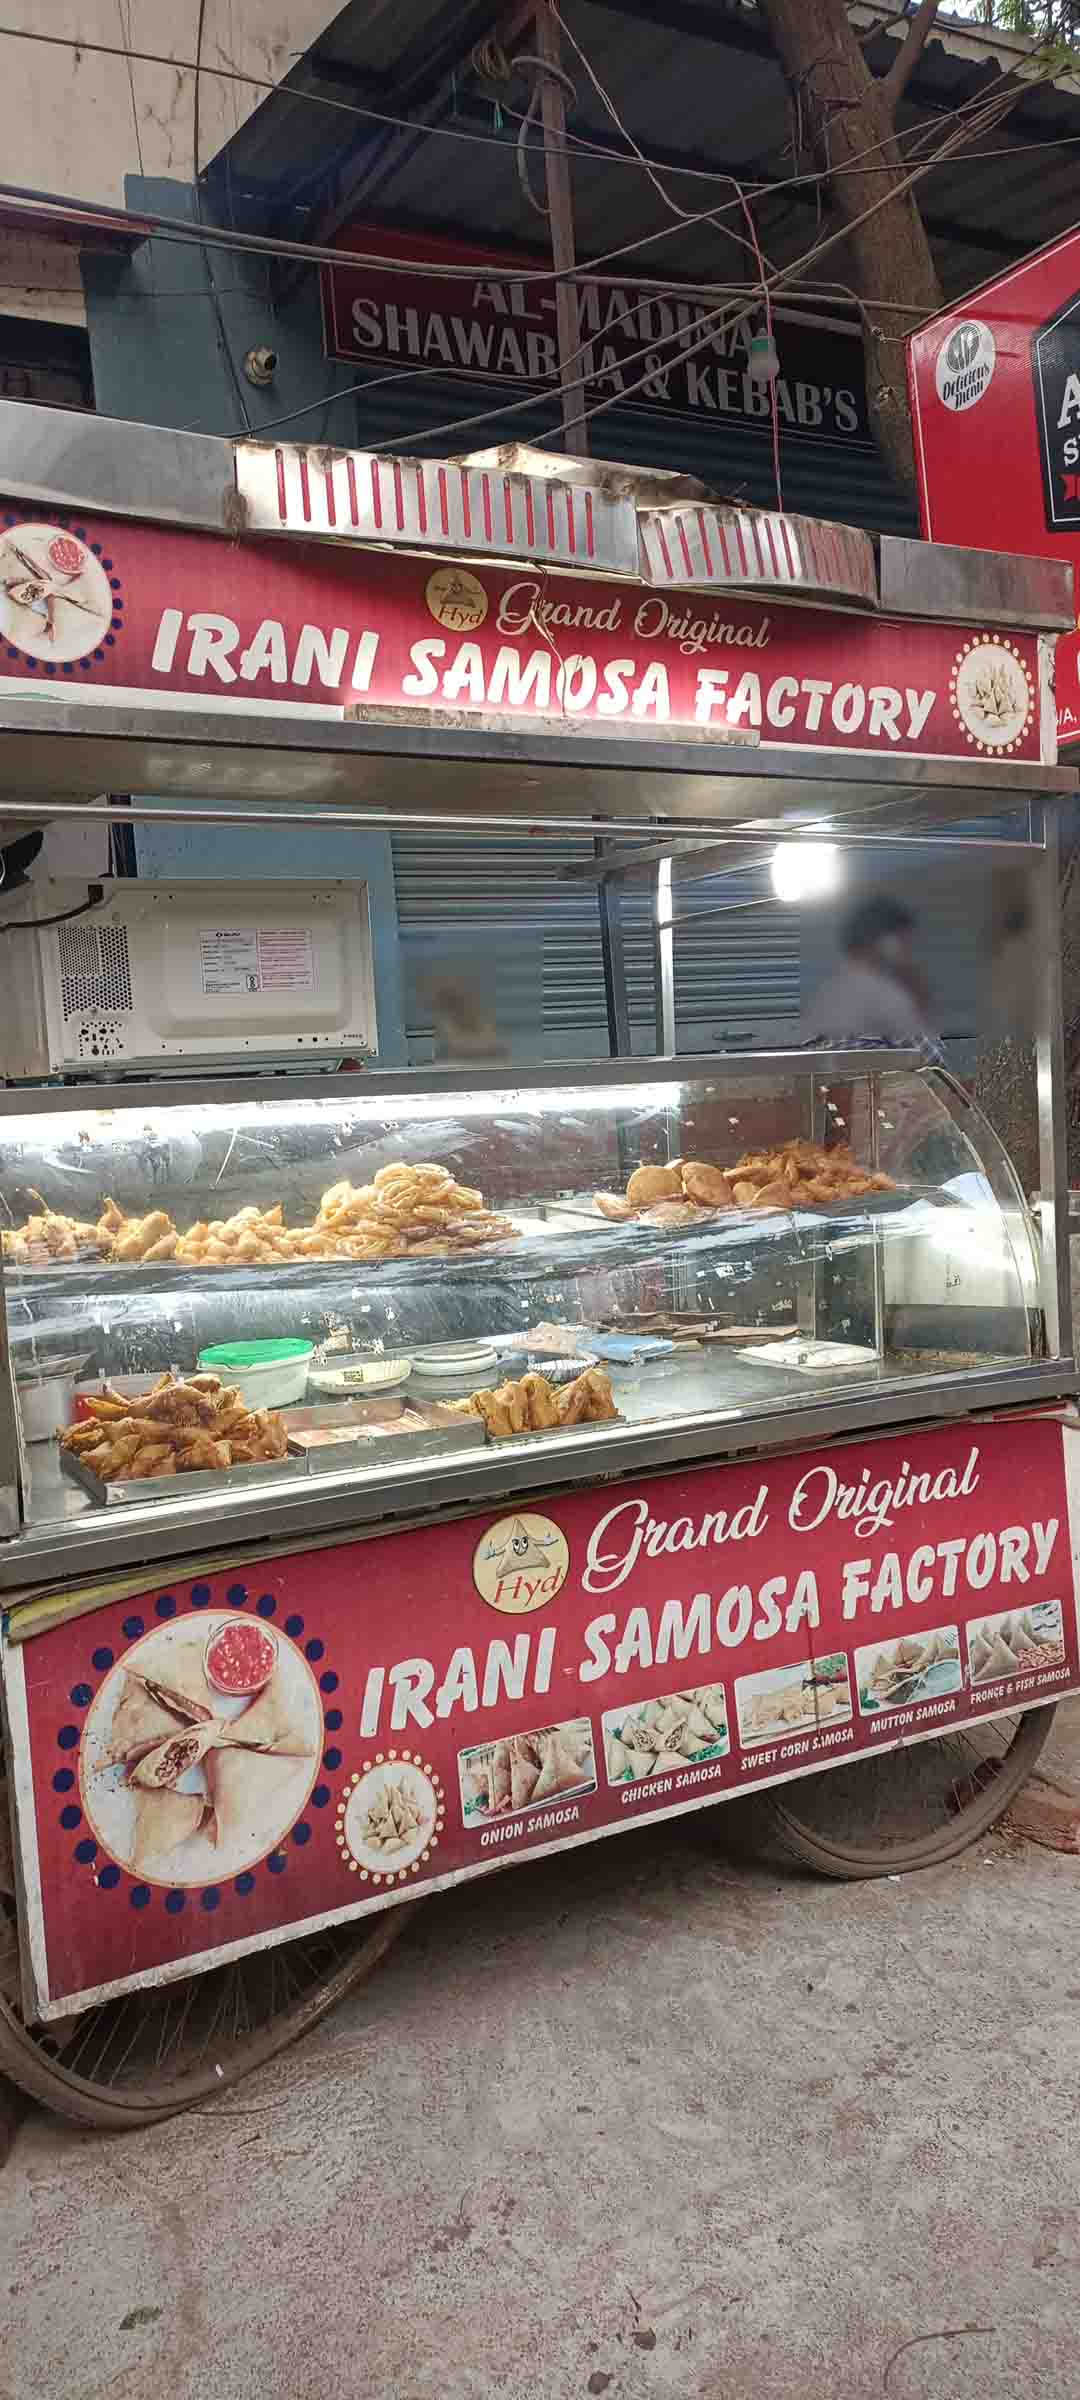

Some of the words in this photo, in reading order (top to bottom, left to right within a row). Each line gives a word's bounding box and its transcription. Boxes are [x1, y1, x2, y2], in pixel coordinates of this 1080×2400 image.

[643, 353, 673, 400] &
[438, 606, 484, 626] Hyd
[496, 582, 622, 636] Grand
[634, 598, 770, 655] Original
[151, 608, 380, 692] IRANI
[402, 638, 672, 722] SAMOSA
[693, 667, 937, 741] FACTORY
[581, 1485, 770, 1593] Grand
[787, 1447, 980, 1537] Original
[494, 1566, 563, 1608] Hyd
[359, 1627, 558, 1738] IRANI
[579, 1569, 822, 1683] SAMOSA
[841, 1518, 1060, 1621] FACTORY
[1015, 1675, 1036, 1692] FISH
[1037, 1667, 1072, 1688] SAMOSA
[870, 1709, 914, 1735] MUTTON
[915, 1699, 957, 1721] SAMOSA
[740, 1750, 778, 1771] SWEET
[780, 1740, 810, 1759] CORN
[811, 1727, 855, 1751] SAMOSA
[620, 1777, 673, 1805] CHICKEN
[675, 1764, 722, 1789] SAMOSA
[480, 1821, 525, 1847] ONION
[526, 1805, 580, 1834] SAMOSA
